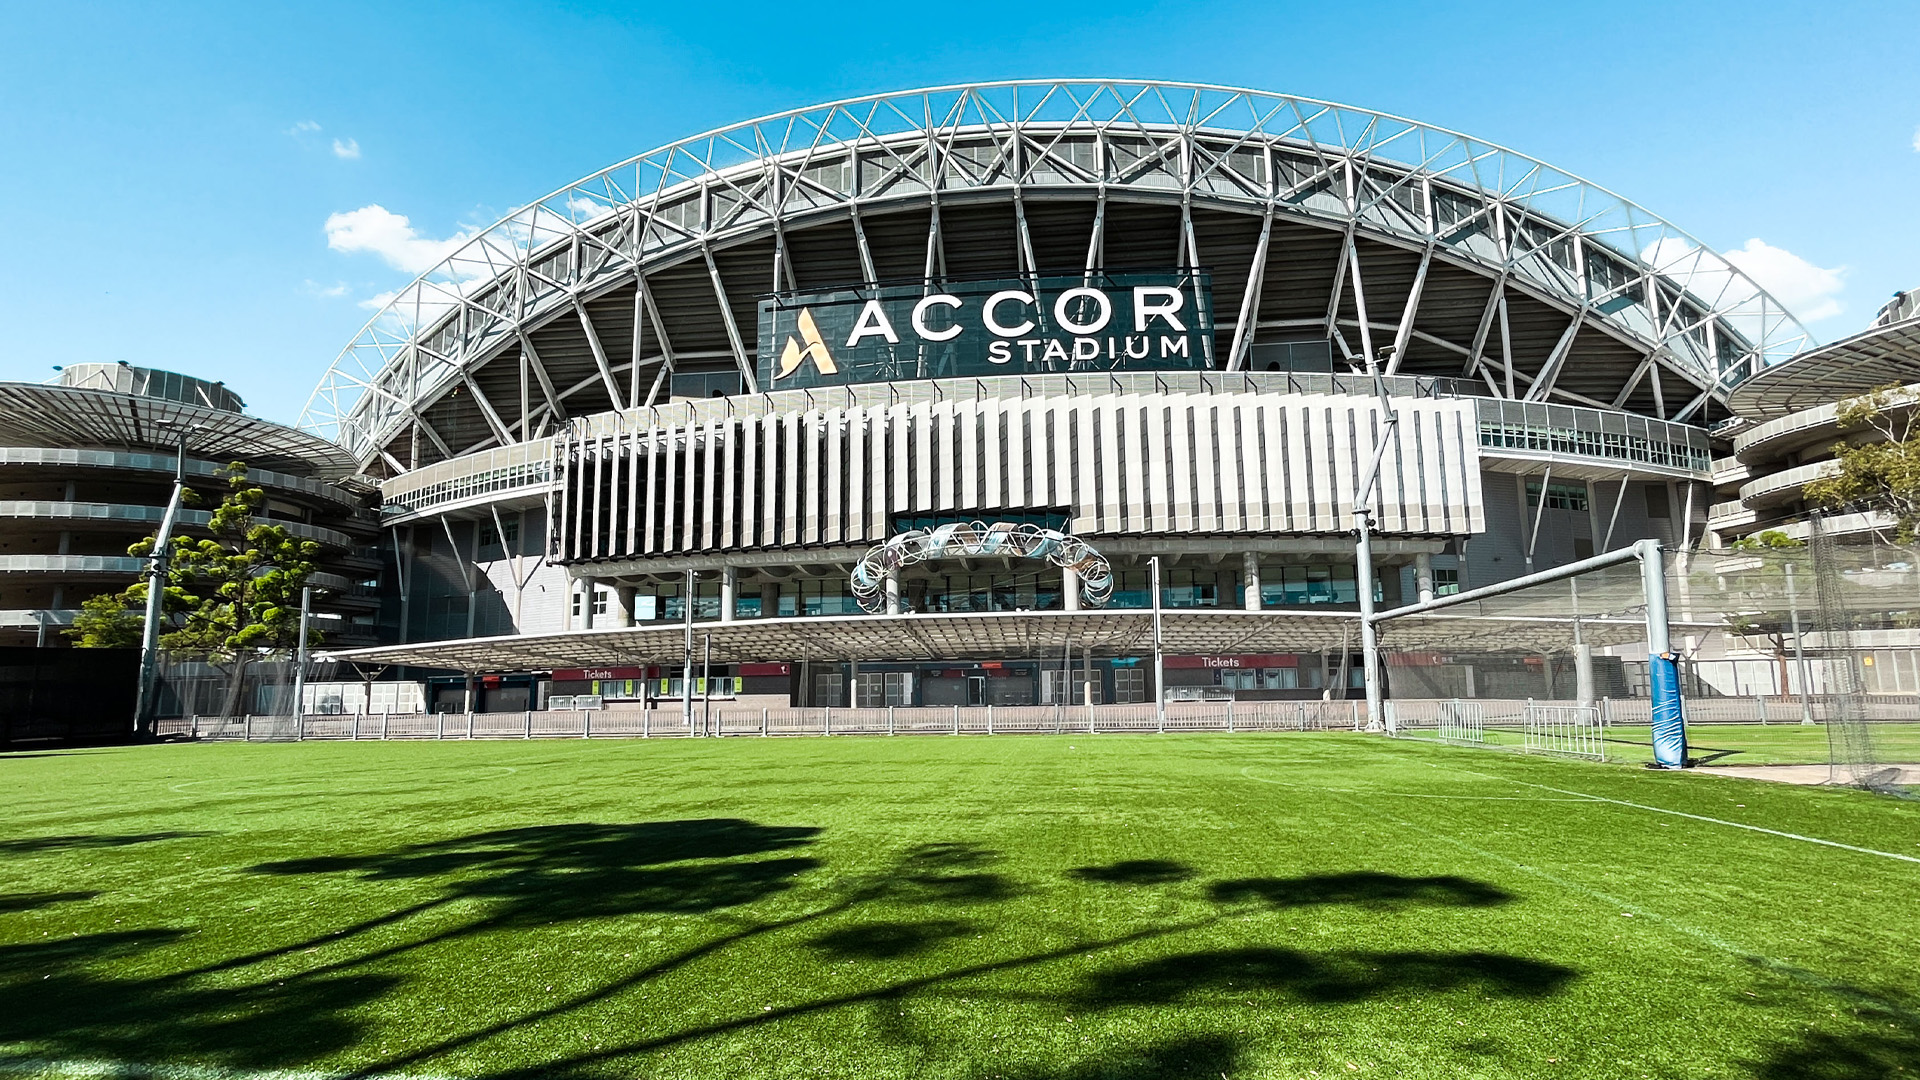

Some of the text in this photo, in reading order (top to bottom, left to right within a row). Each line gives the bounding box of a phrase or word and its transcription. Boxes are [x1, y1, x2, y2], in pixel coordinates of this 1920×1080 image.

[846, 287, 1188, 347] ACCOR
[987, 336, 1189, 364] STADIUM
[1201, 657, 1240, 668] Tickets
[583, 669, 612, 679] Tickets
